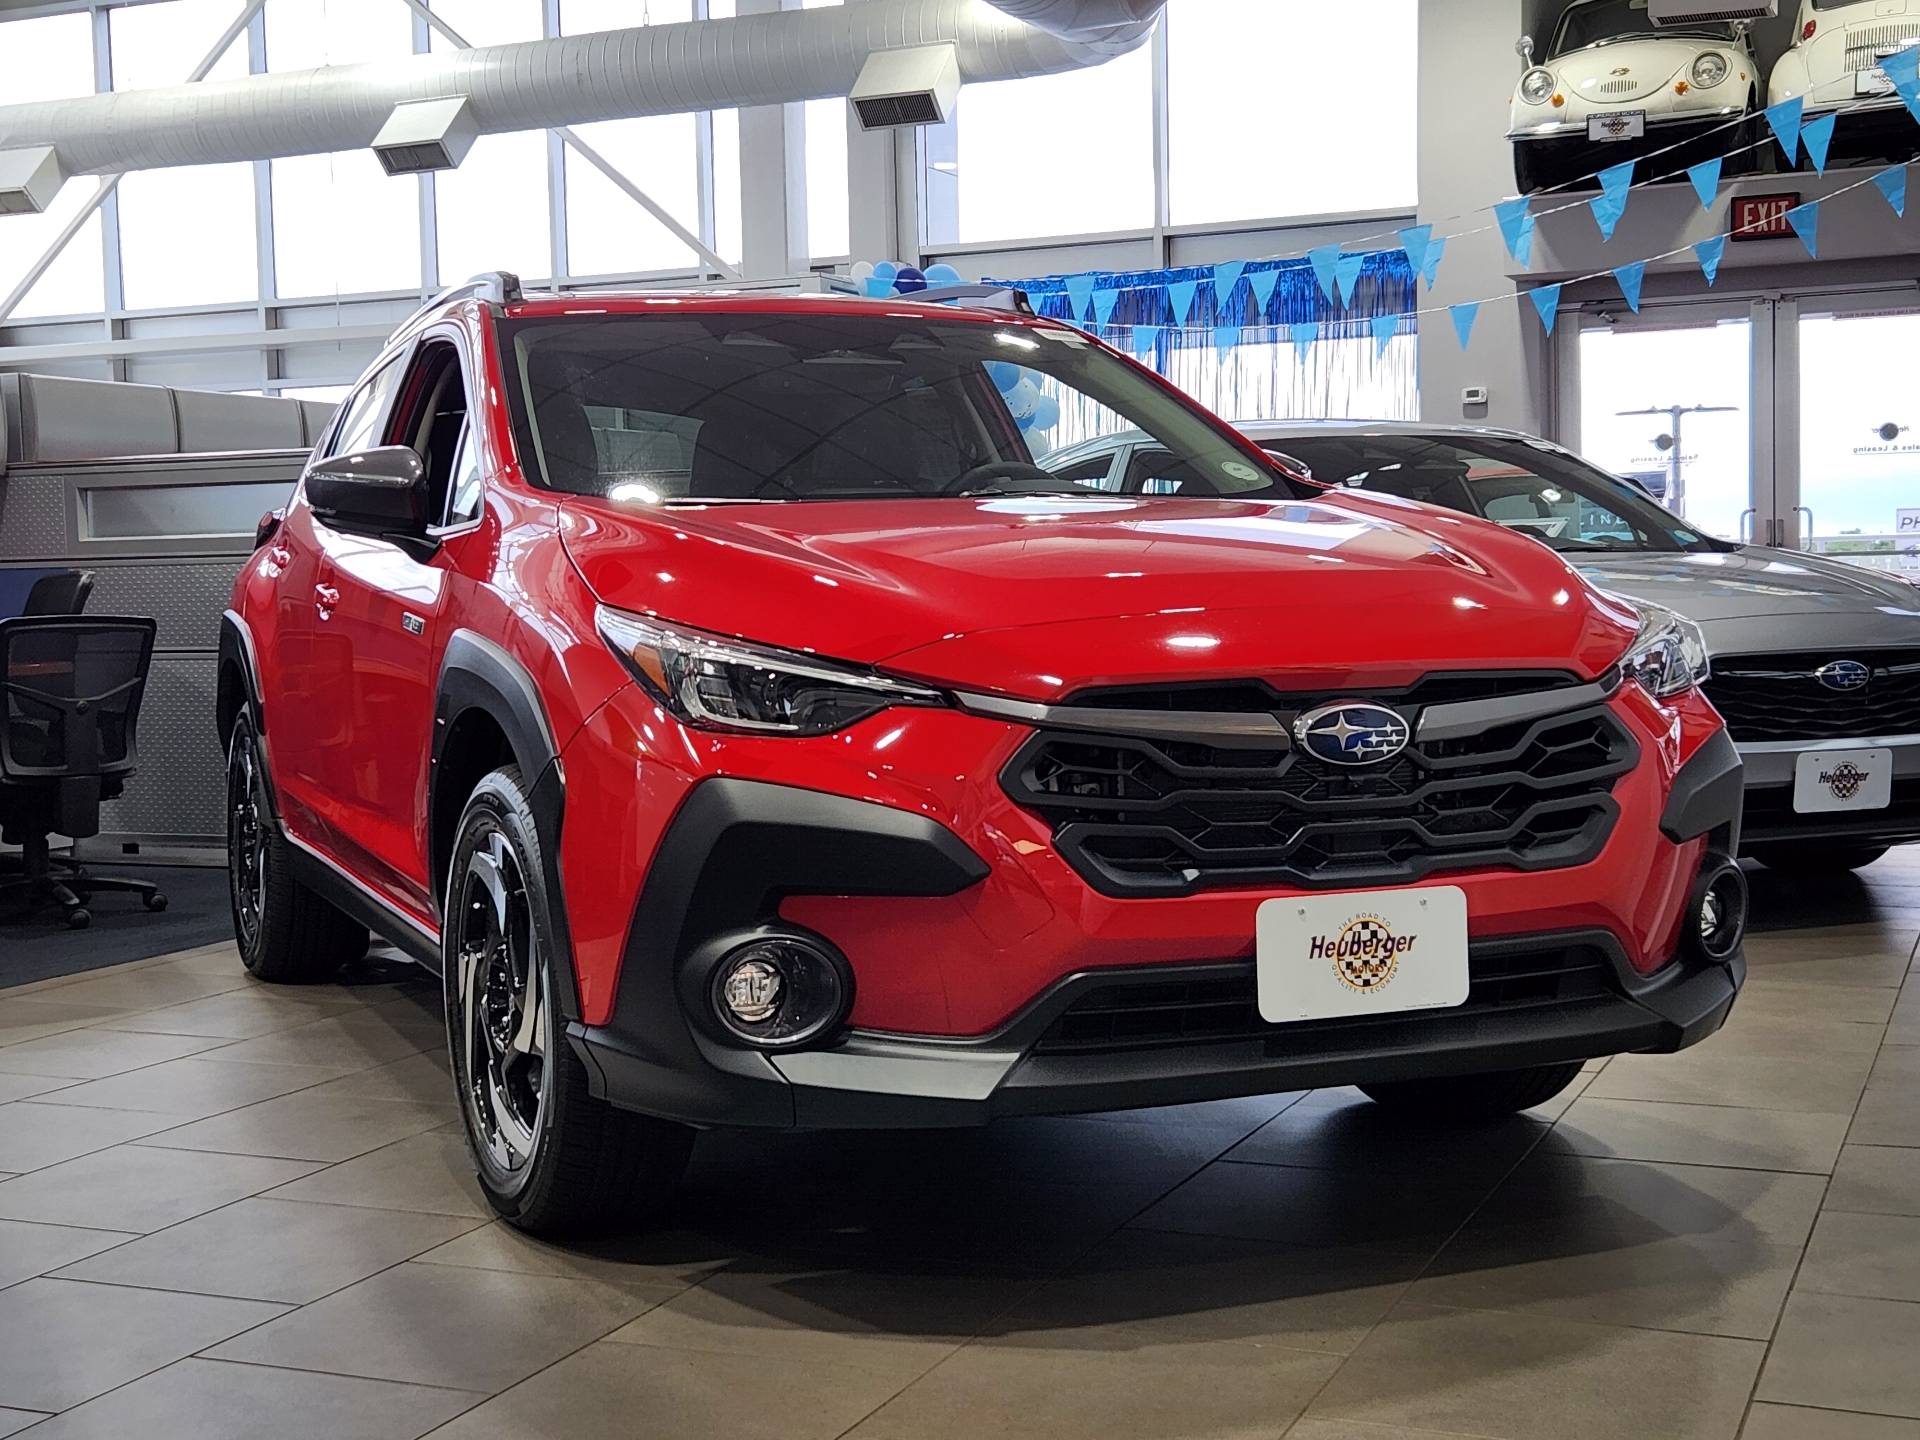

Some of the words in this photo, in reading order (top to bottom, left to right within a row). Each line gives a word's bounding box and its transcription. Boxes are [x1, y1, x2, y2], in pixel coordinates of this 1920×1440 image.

[1744, 201, 1788, 233] EXIT
[1818, 770, 1869, 784] Heuberger
[1337, 916, 1353, 932] THE
[1355, 912, 1379, 921] ROAD
[1380, 916, 1392, 928] TO
[1309, 930, 1418, 960] Heuberger
[1331, 963, 1358, 995] QUALITY
[1369, 960, 1401, 995] ECONOMY
[1350, 963, 1386, 977] MOTORS
